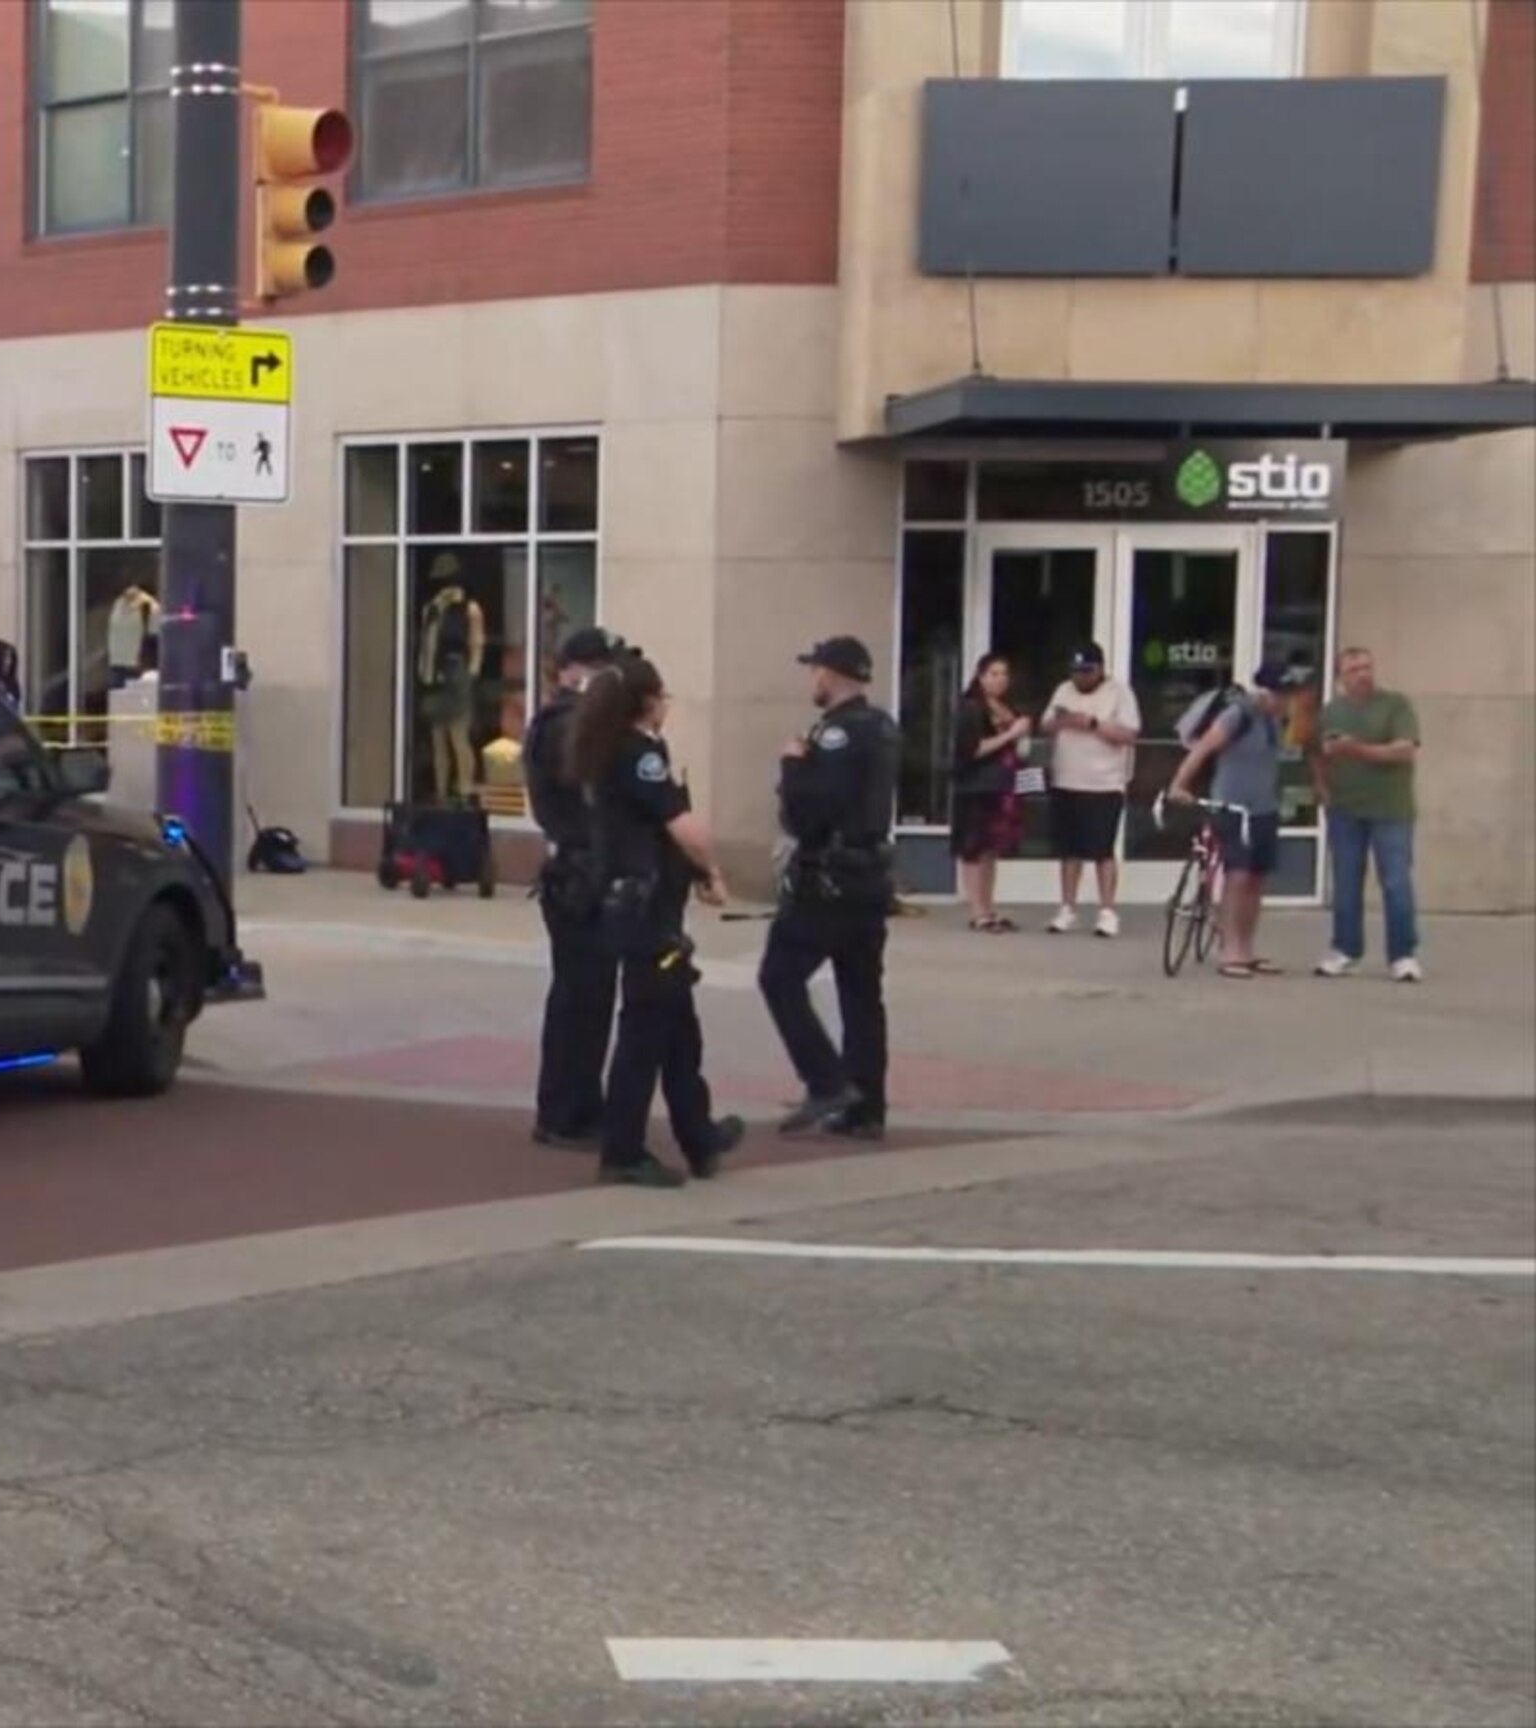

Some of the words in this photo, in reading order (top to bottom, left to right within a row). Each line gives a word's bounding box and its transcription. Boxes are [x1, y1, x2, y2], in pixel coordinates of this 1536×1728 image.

[160, 337, 236, 363] TURNING
[160, 367, 244, 390] VEHICLES
[216, 441, 237, 462] TO
[1228, 453, 1331, 498] stio
[1082, 480, 1152, 508] 1505
[1168, 640, 1217, 663] stio
